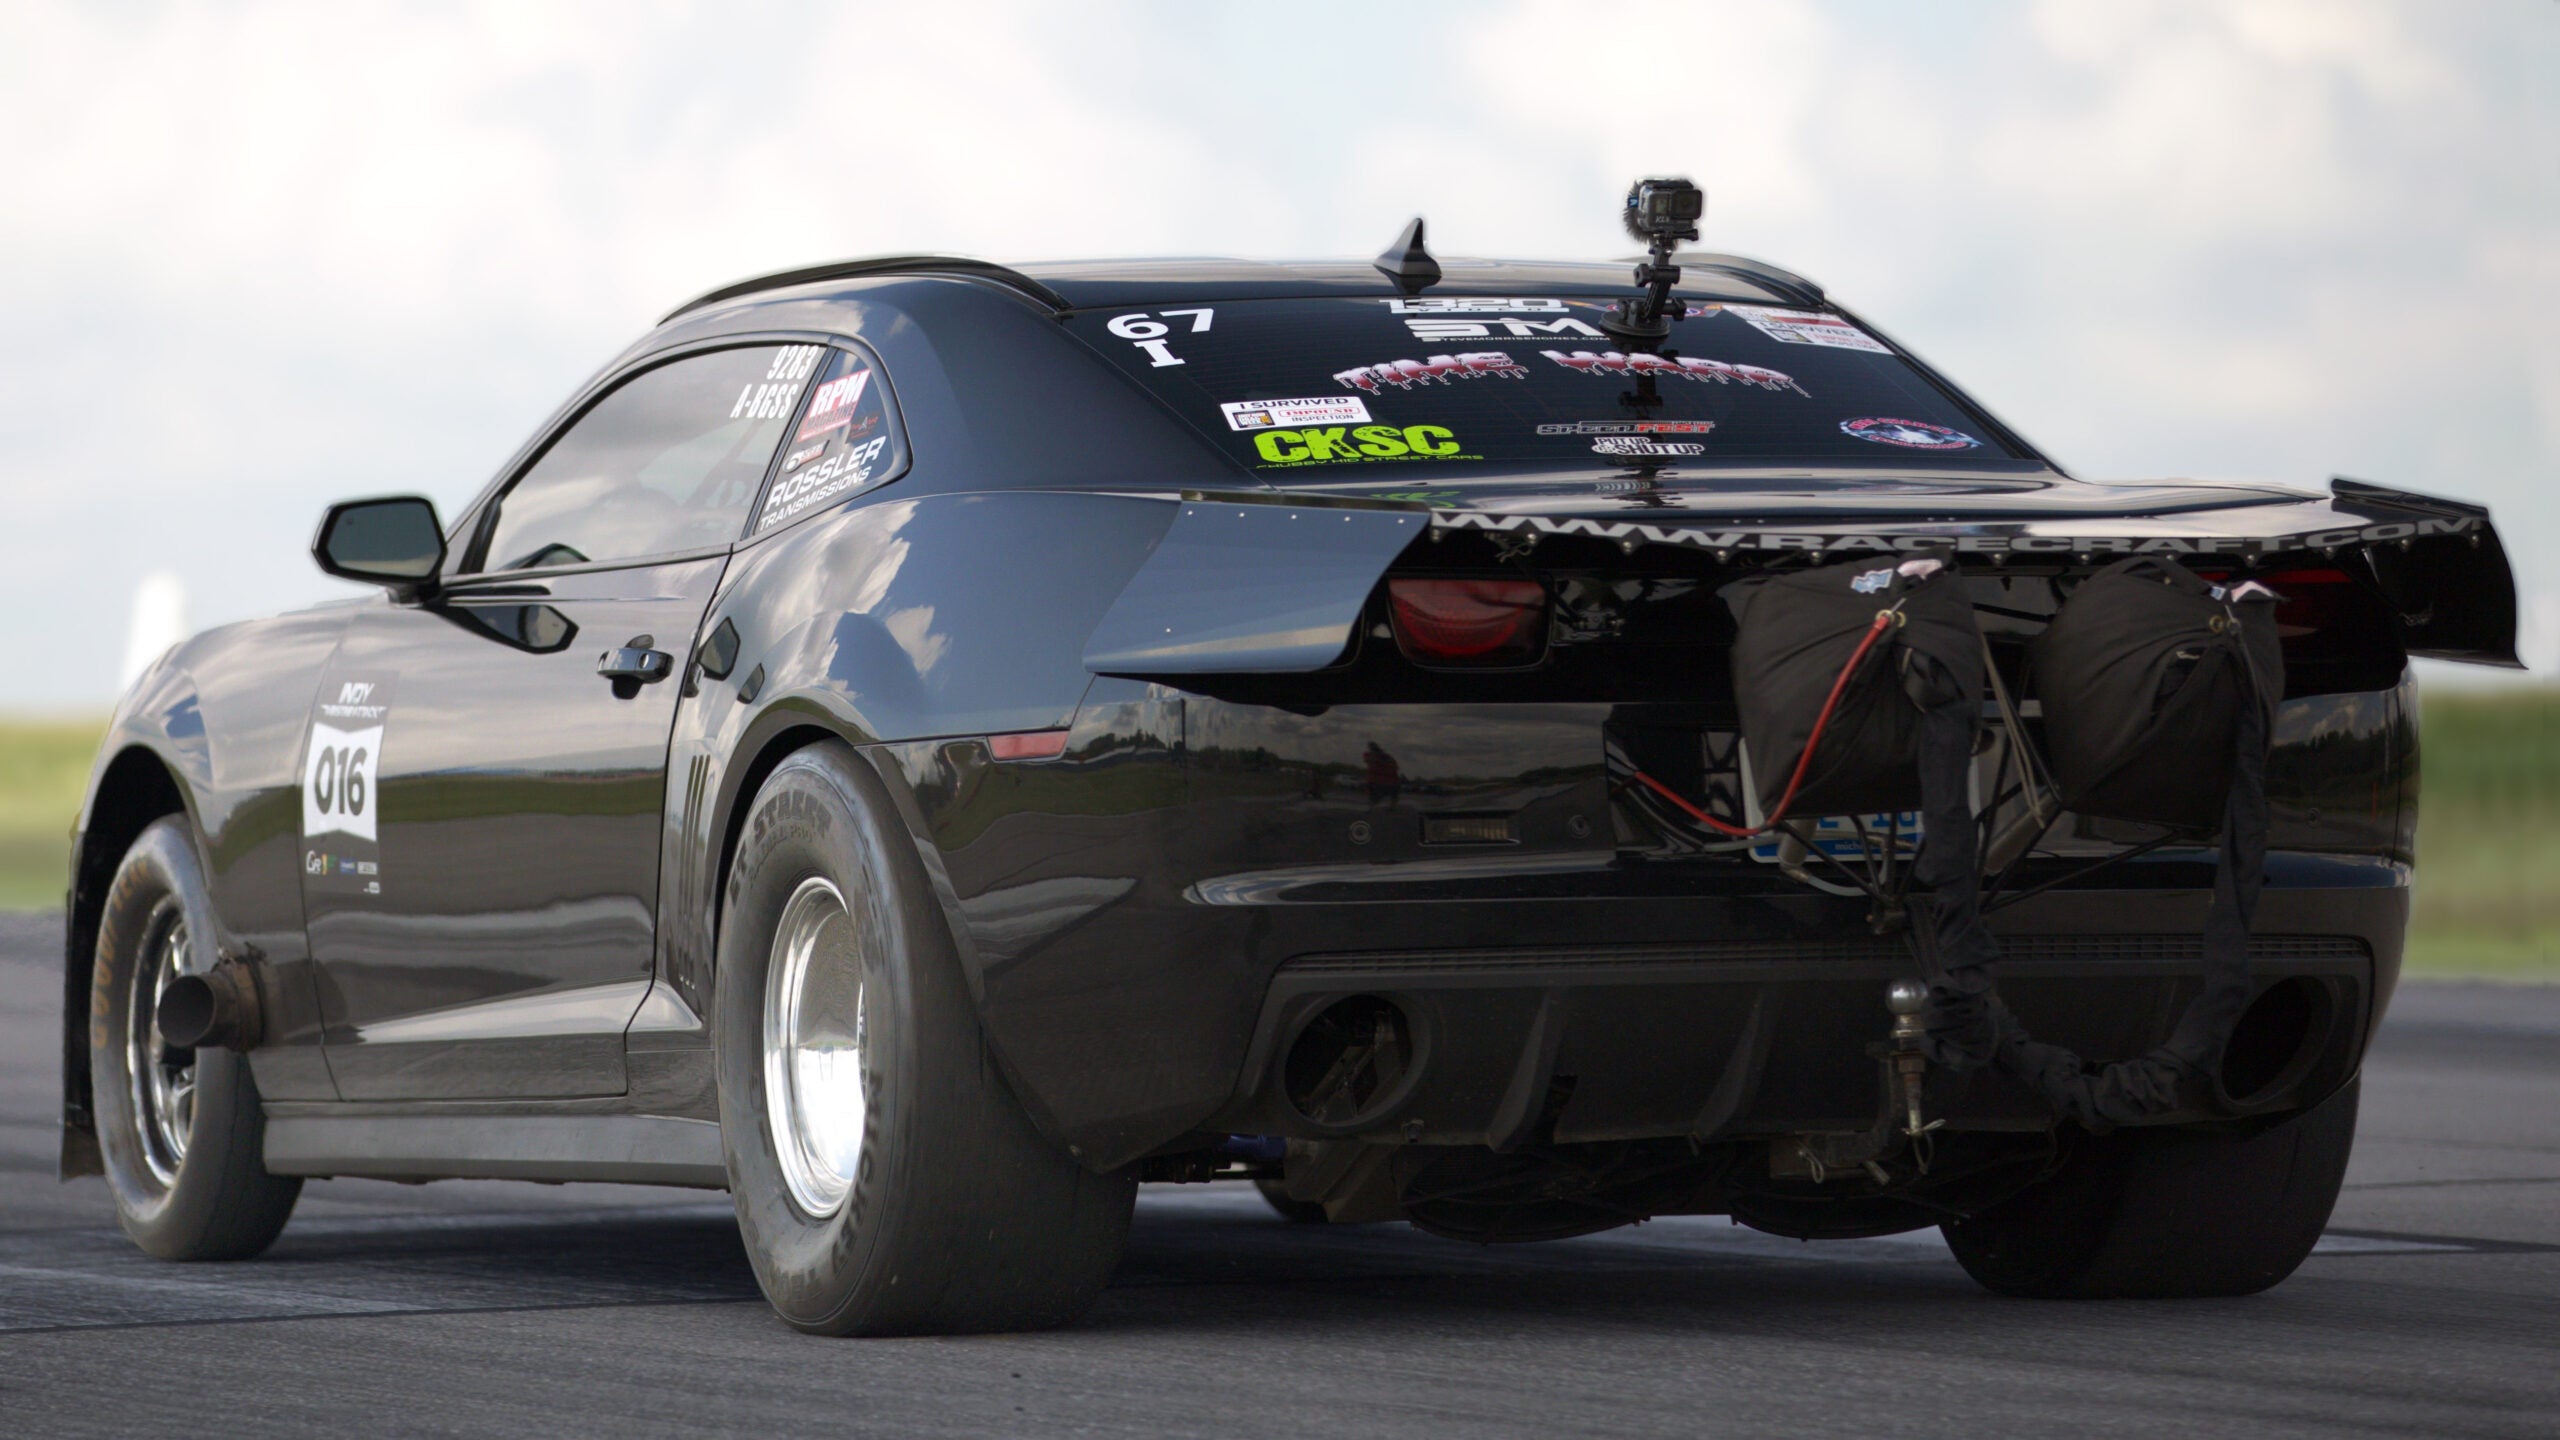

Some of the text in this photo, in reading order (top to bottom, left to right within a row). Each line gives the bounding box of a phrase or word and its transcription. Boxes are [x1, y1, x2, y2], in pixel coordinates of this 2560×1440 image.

[1379, 298, 1562, 309] 1320
[1107, 308, 1214, 339] 67
[767, 345, 819, 380] 9283
[810, 369, 870, 417] RPM
[1251, 397, 1348, 409] SURVIVED
[1291, 414, 1354, 423] INSPECTION
[1253, 426, 1461, 463] CKSC
[1617, 444, 1671, 454] SHUT
[1675, 444, 1703, 454] UP
[765, 436, 886, 512] ROSSLER
[759, 466, 872, 531] TRANSMISSIONS
[338, 682, 375, 704] INDY
[314, 745, 368, 817] 016
[754, 788, 832, 843] STREET
